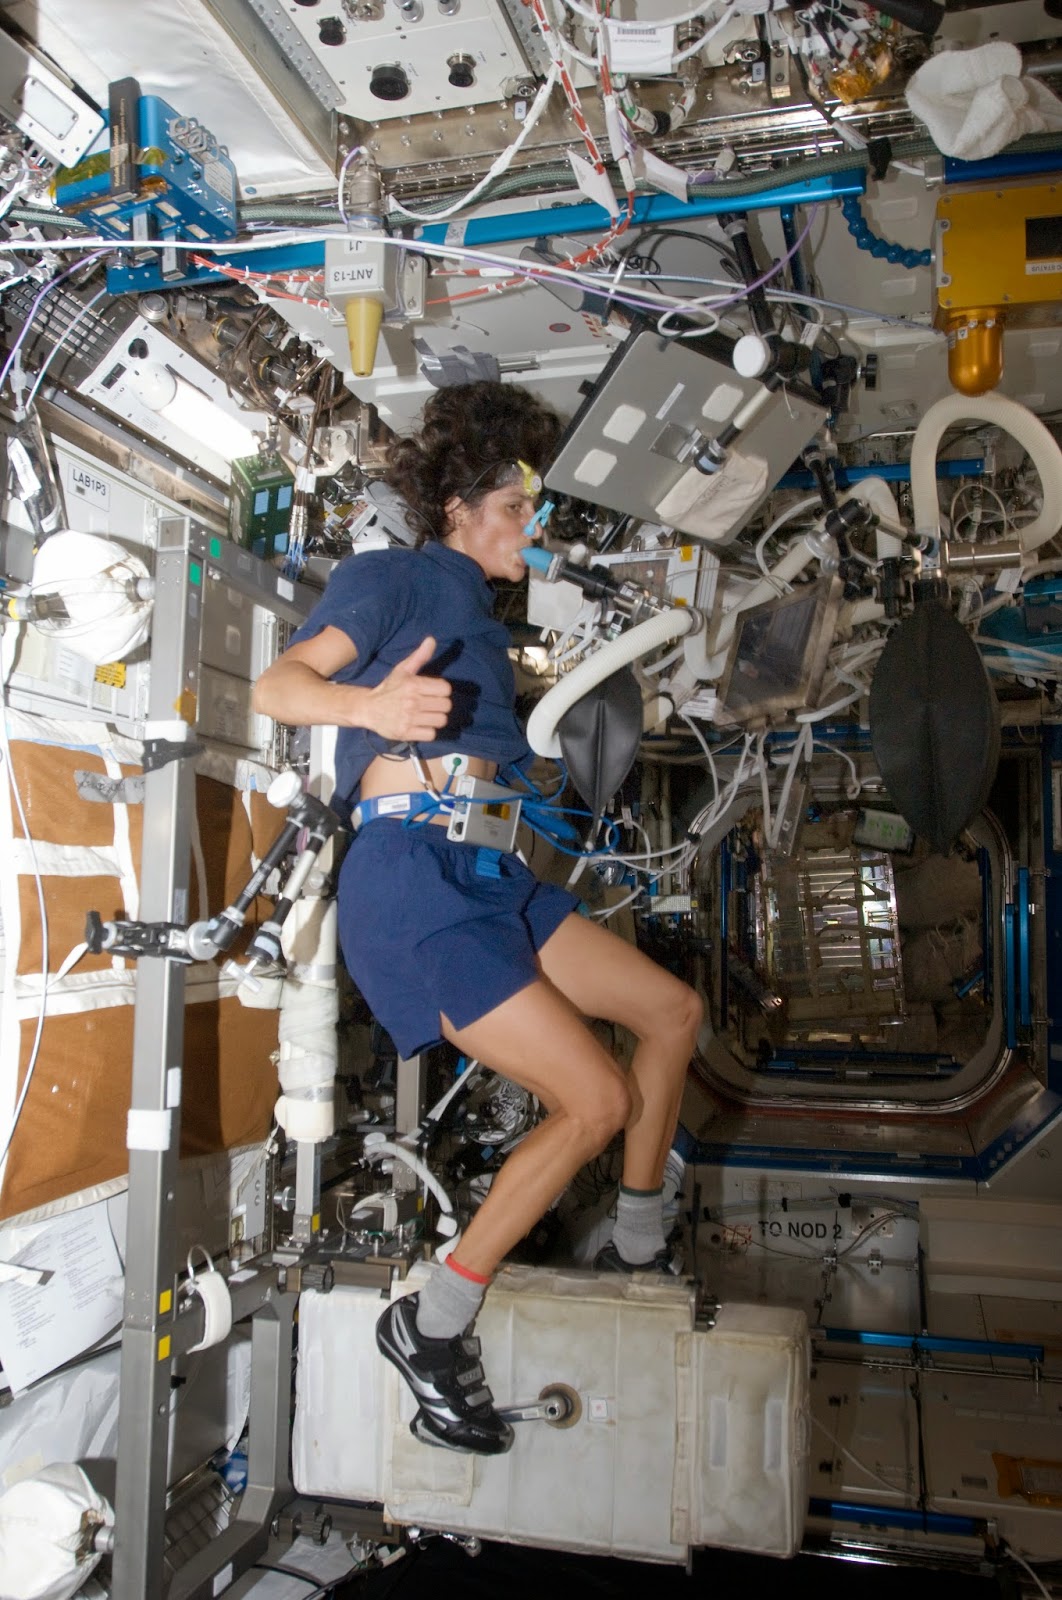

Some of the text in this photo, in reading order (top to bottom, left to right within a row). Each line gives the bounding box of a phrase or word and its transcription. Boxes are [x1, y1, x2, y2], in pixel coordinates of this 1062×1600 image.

[349, 240, 362, 251] J1
[333, 268, 374, 282] ANT-13
[1031, 264, 1056, 272] STATUS
[72, 468, 106, 496] LAB1P3
[758, 1221, 782, 1237] TO
[788, 1222, 827, 1239] NOD
[833, 1224, 842, 1239] 2
